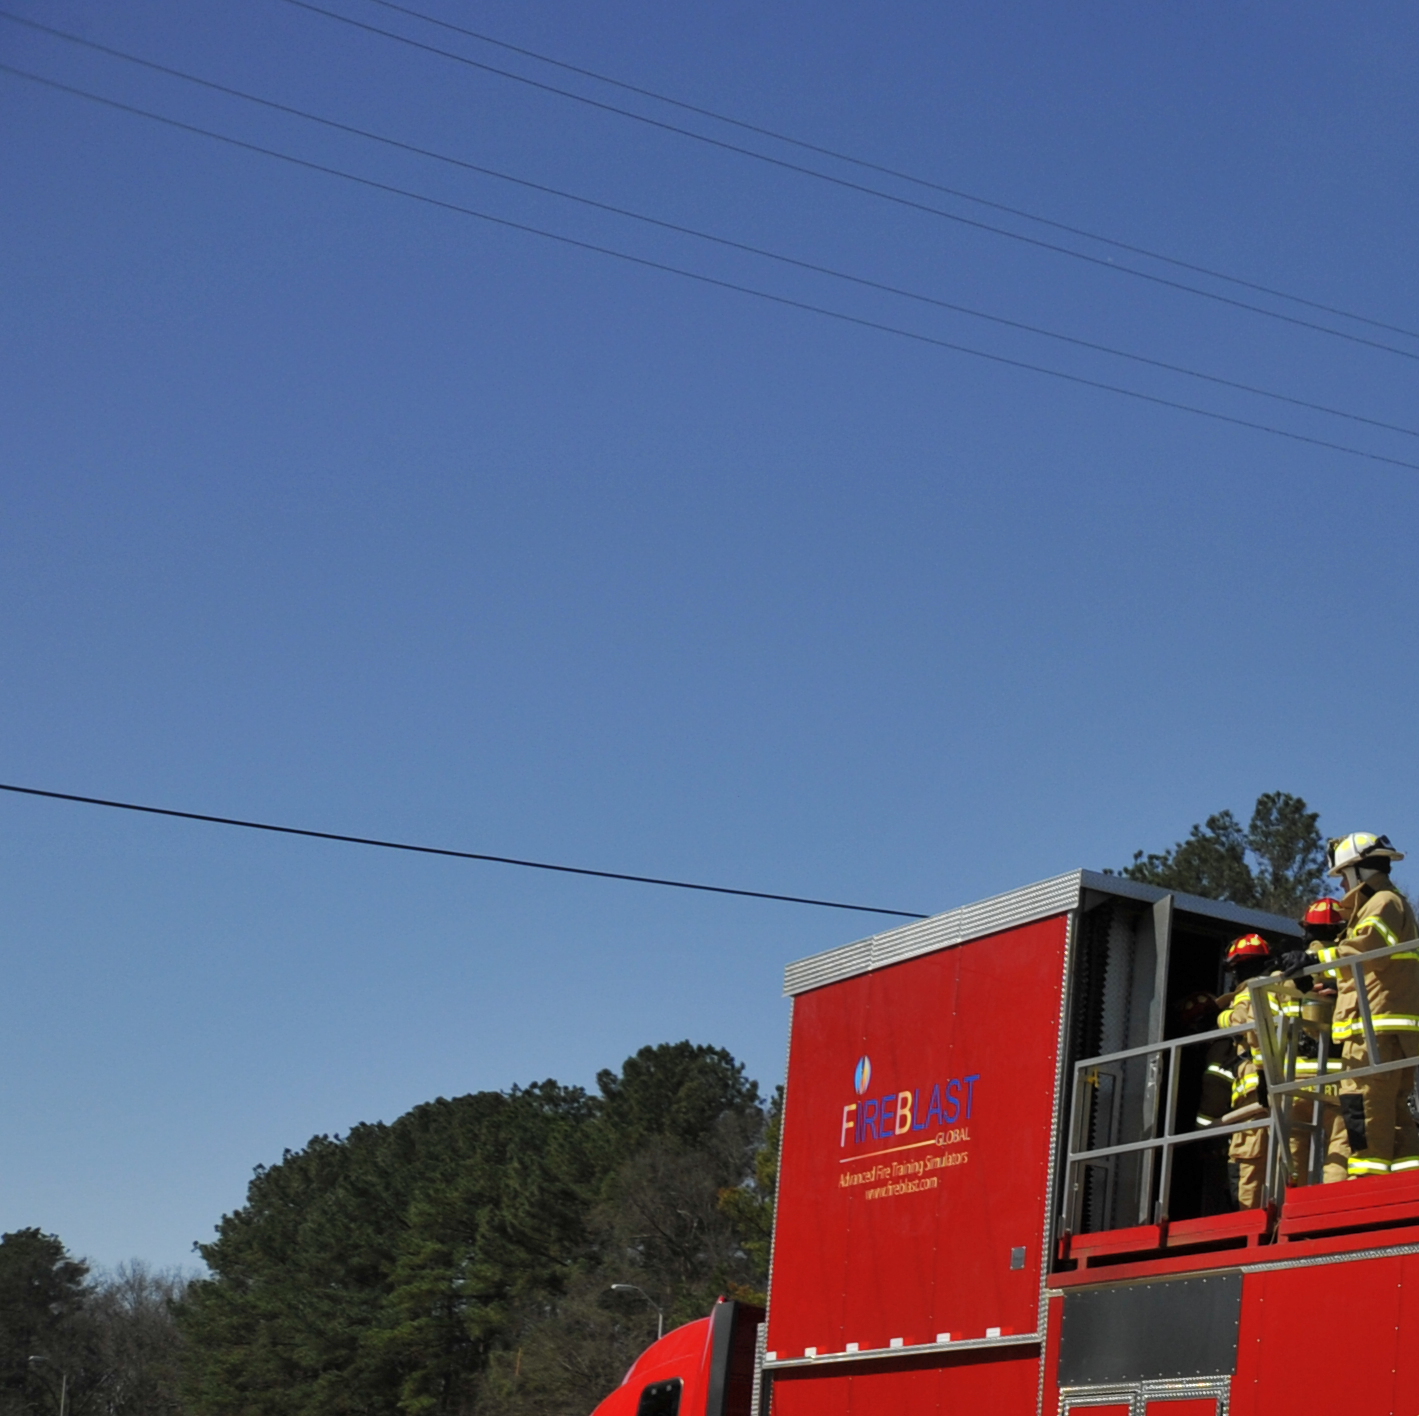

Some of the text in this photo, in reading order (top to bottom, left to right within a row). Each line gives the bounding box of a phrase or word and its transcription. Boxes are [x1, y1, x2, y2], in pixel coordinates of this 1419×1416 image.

[840, 1073, 981, 1148] FIREBLAST
[935, 1127, 971, 1147] GLOBAL
[838, 1151, 968, 1188] Advanced Fire Training Simulators
[865, 1177, 938, 1200] www.fireblast.com
